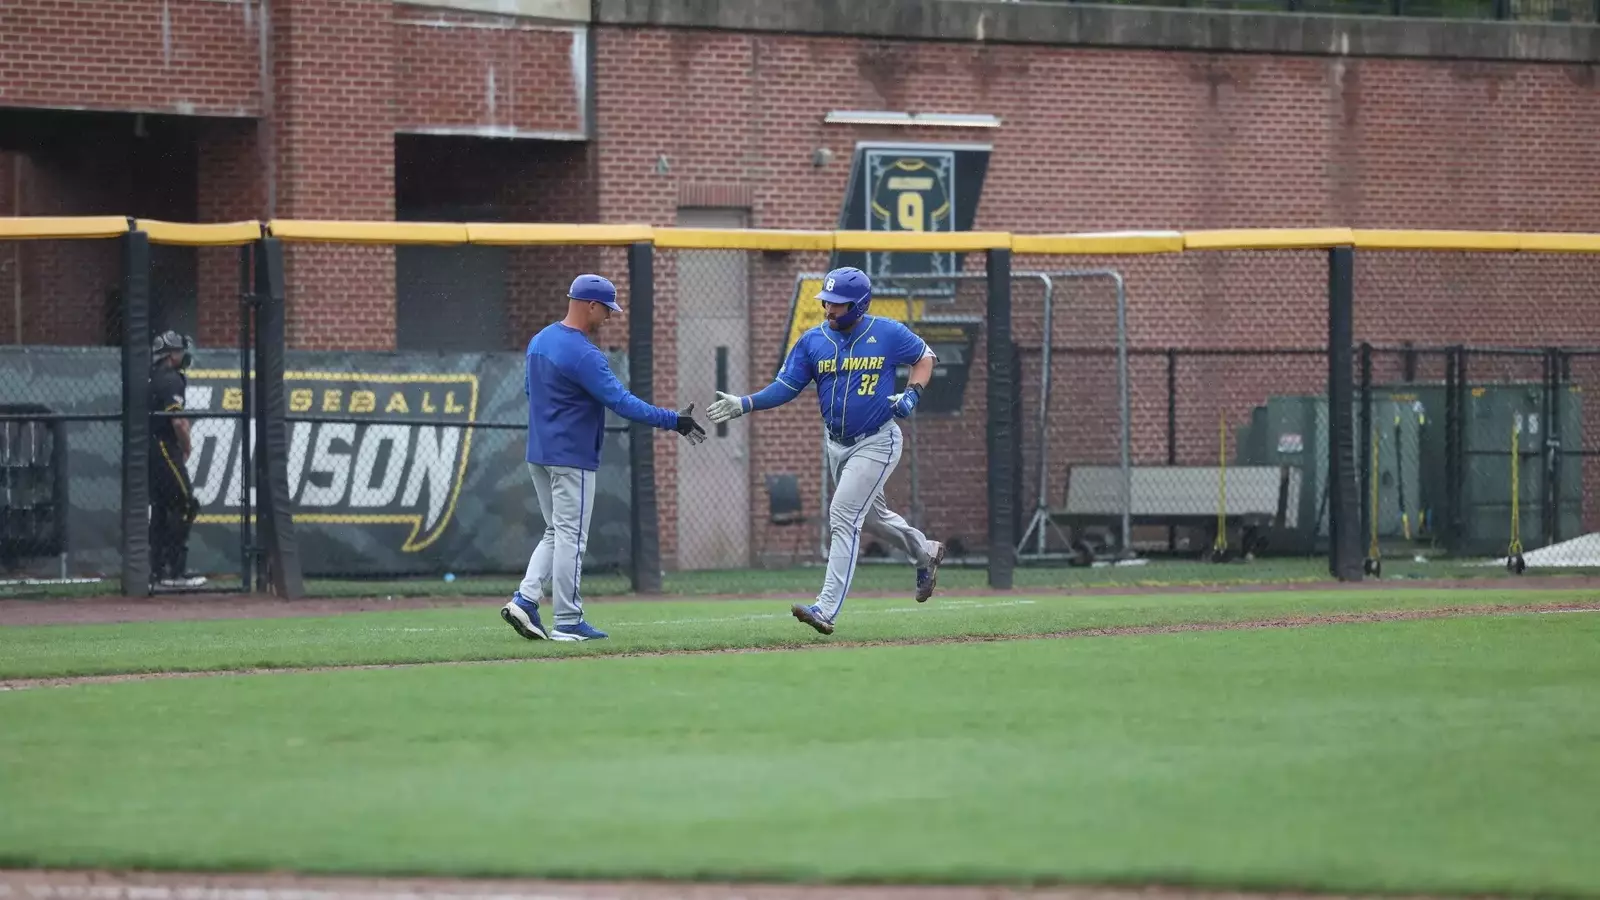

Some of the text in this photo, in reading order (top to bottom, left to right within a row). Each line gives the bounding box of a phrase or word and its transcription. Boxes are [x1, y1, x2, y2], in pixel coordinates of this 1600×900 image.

[898, 192, 923, 232] 9
[818, 357, 885, 373] DELAWARE
[857, 374, 879, 395] 32
[222, 387, 464, 413] BSEBALL
[185, 387, 461, 532] OSON
